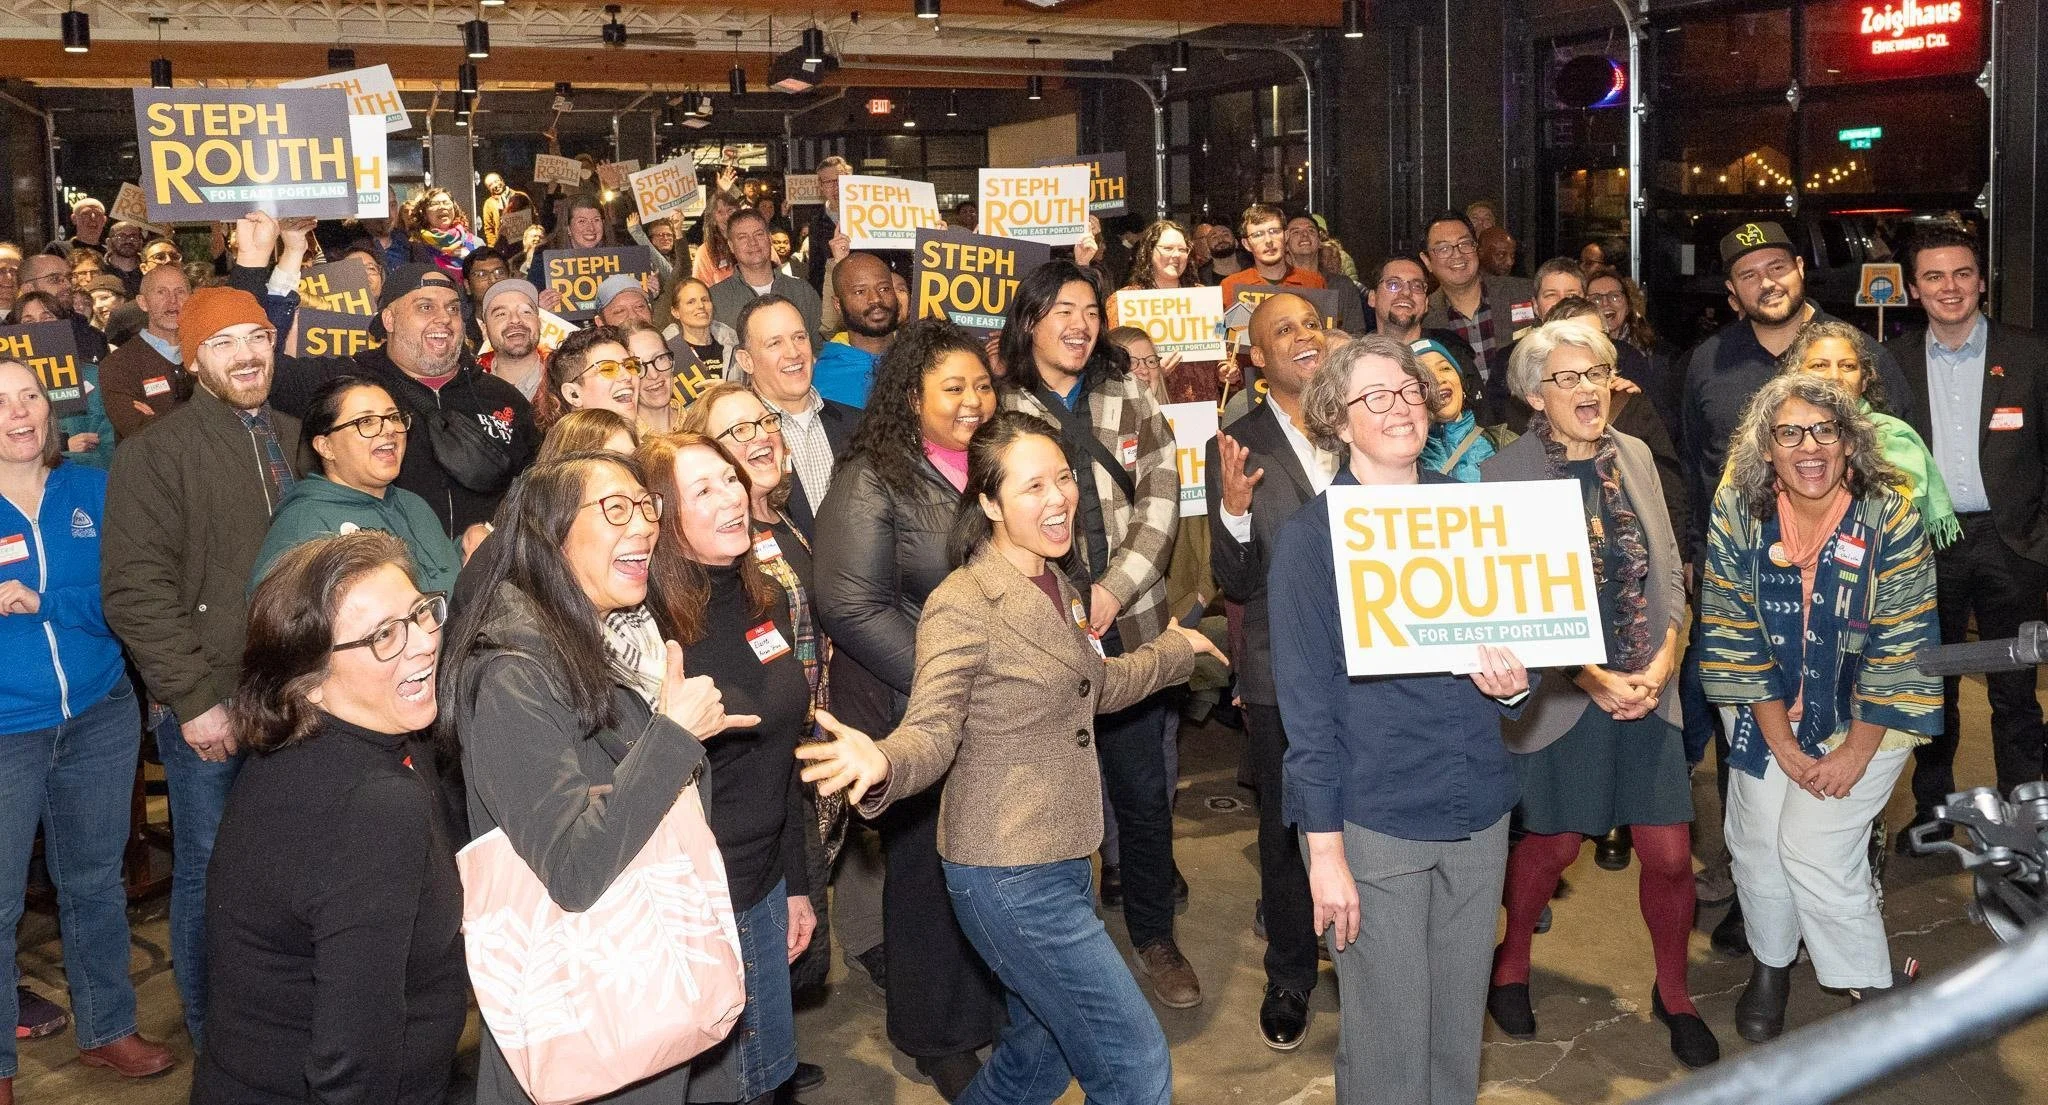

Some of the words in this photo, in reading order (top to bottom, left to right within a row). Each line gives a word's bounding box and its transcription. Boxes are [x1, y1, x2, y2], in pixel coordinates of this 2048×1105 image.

[1861, 0, 1961, 37] Zoiglhaus
[872, 99, 889, 114] EXIT
[147, 103, 288, 137] STEPH
[150, 137, 347, 205] ROUTH
[635, 165, 680, 191] STEPH
[210, 189, 236, 200] FOR
[278, 185, 346, 198] PORTLAND
[640, 174, 697, 217] ROUTH
[844, 183, 911, 203] STEPH
[985, 176, 1059, 198] STEPH
[846, 204, 938, 239] ROUTH
[985, 197, 1085, 237] ROUTH
[873, 231, 887, 239] FOR
[1013, 227, 1028, 236] FOR
[1030, 226, 1048, 236] EAST
[1049, 225, 1085, 235] PORTLAND
[550, 254, 620, 277] STEPH
[921, 240, 1015, 276] STEPH
[580, 302, 595, 311] FOR
[919, 270, 1020, 320] ROUT
[1124, 297, 1191, 318] STEPH
[955, 315, 974, 325] FOR
[976, 317, 1000, 328] EAST
[1166, 344, 1183, 352] EAST
[1185, 342, 1220, 351] PORTLAND
[1343, 505, 1507, 552] STEPH
[1348, 551, 1586, 649] ROUTH
[1418, 628, 1449, 642] FOR
[1454, 626, 1493, 641] EAST
[1499, 622, 1587, 639] PORTLAND
